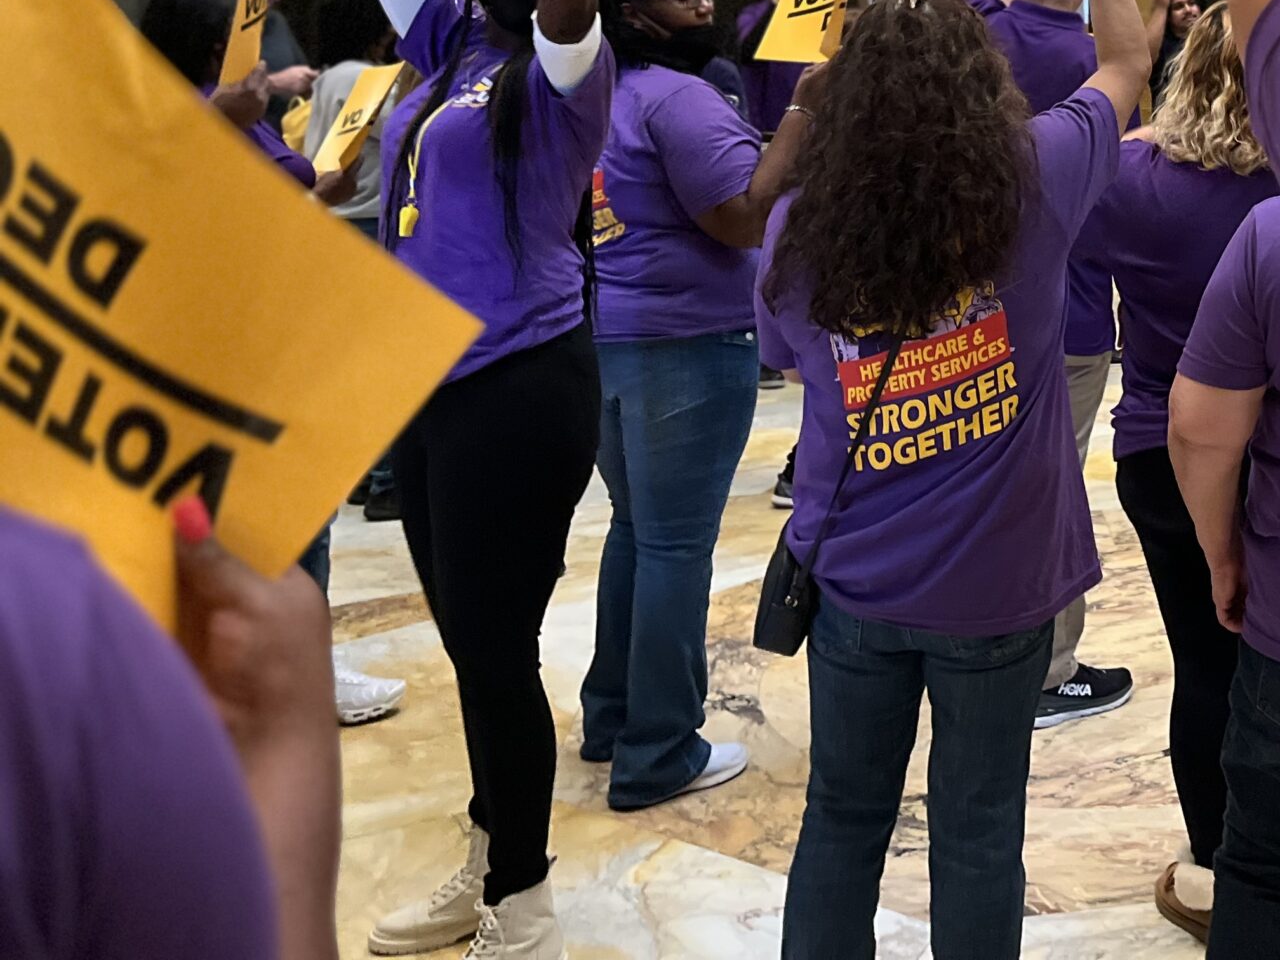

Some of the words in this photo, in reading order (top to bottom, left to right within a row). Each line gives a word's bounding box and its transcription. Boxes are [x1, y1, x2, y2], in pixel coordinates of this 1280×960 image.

[847, 368, 926, 405] PROERTY
[930, 337, 1007, 382] SERVICES
[859, 333, 969, 382] HELTHCARE
[972, 327, 986, 346] &
[0, 305, 236, 526] VOTE
[846, 361, 1018, 439] STRONGER
[847, 394, 1020, 471] TOGETHER
[1058, 683, 1092, 696] HOKA
